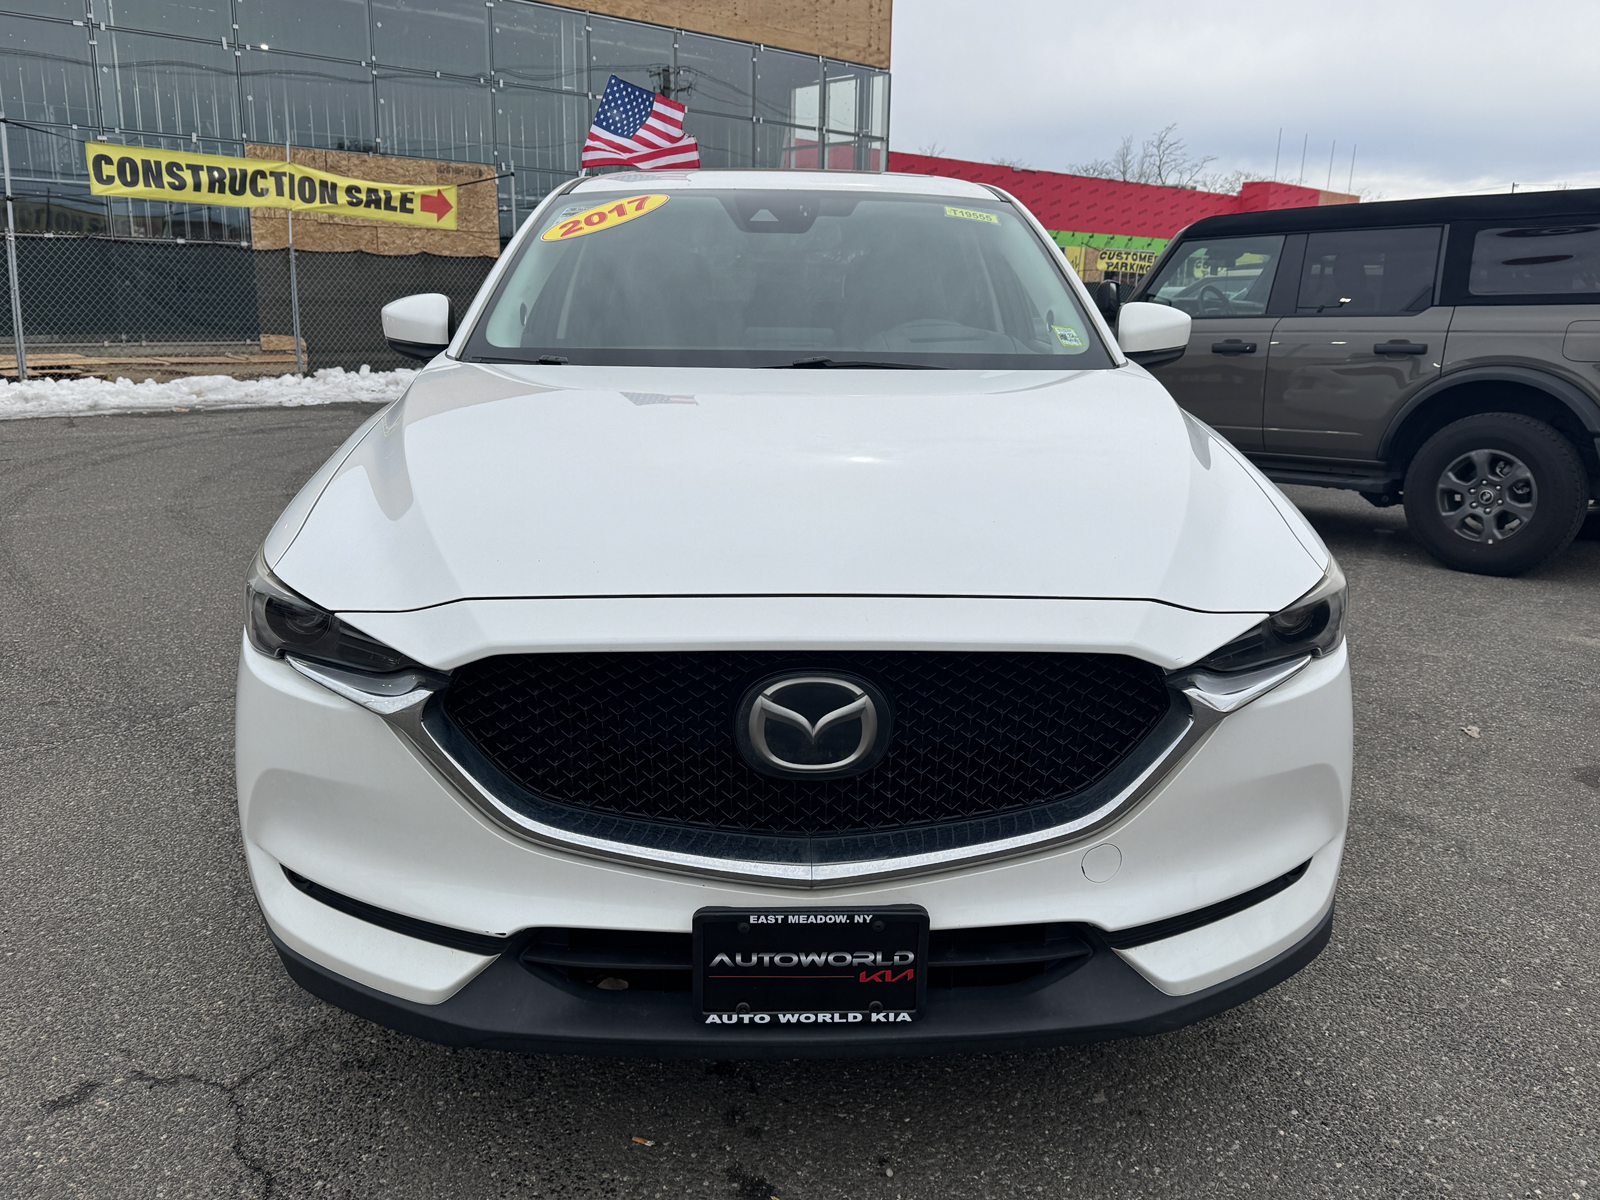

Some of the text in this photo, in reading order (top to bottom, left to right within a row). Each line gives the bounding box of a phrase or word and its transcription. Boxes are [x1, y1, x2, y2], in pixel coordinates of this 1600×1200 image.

[91, 153, 415, 214] CONSTRUCTION SALE
[559, 196, 651, 238] 2017
[950, 208, 993, 222] T19555
[749, 915, 785, 924] EAST
[854, 915, 873, 924] NY
[708, 951, 915, 967] AUTOWORLD
[859, 968, 915, 983] KIA
[705, 1012, 913, 1024] AUTO WORLD KIA
